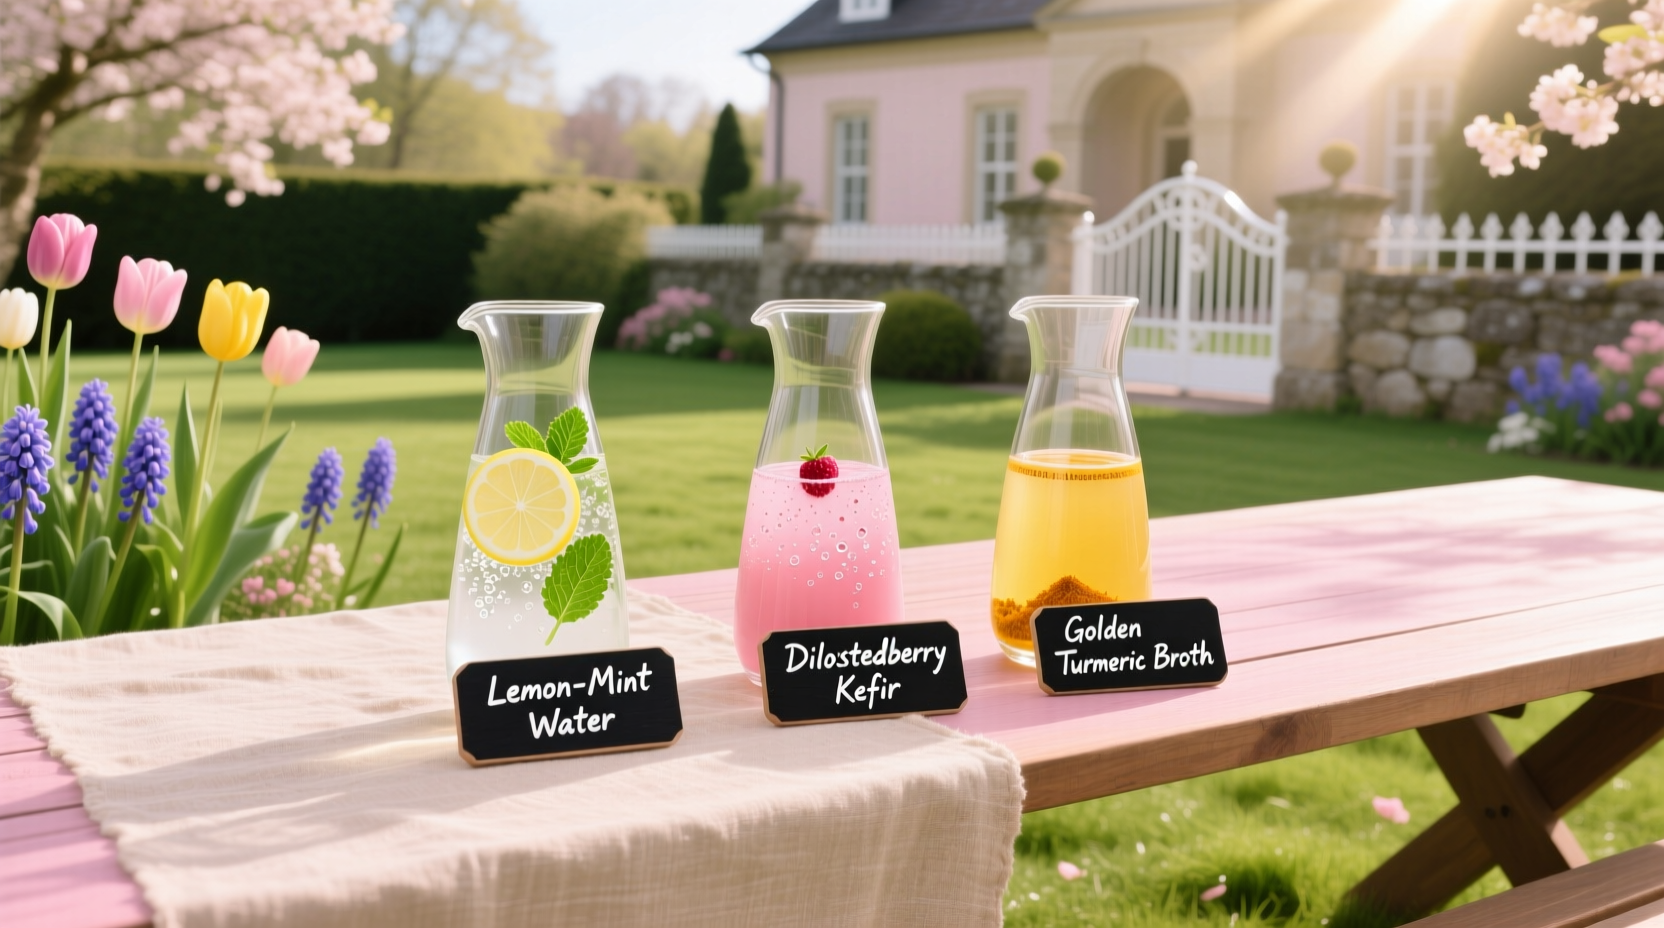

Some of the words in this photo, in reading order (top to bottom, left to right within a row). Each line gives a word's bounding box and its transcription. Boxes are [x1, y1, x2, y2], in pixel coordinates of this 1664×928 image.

[1065, 614, 1142, 643] Golden
[1057, 650, 1146, 676] Turmeric
[1154, 640, 1214, 669] Broth
[488, 663, 652, 706] Lemon-Mint
[836, 673, 902, 709] Kefir
[529, 706, 616, 739] Water
